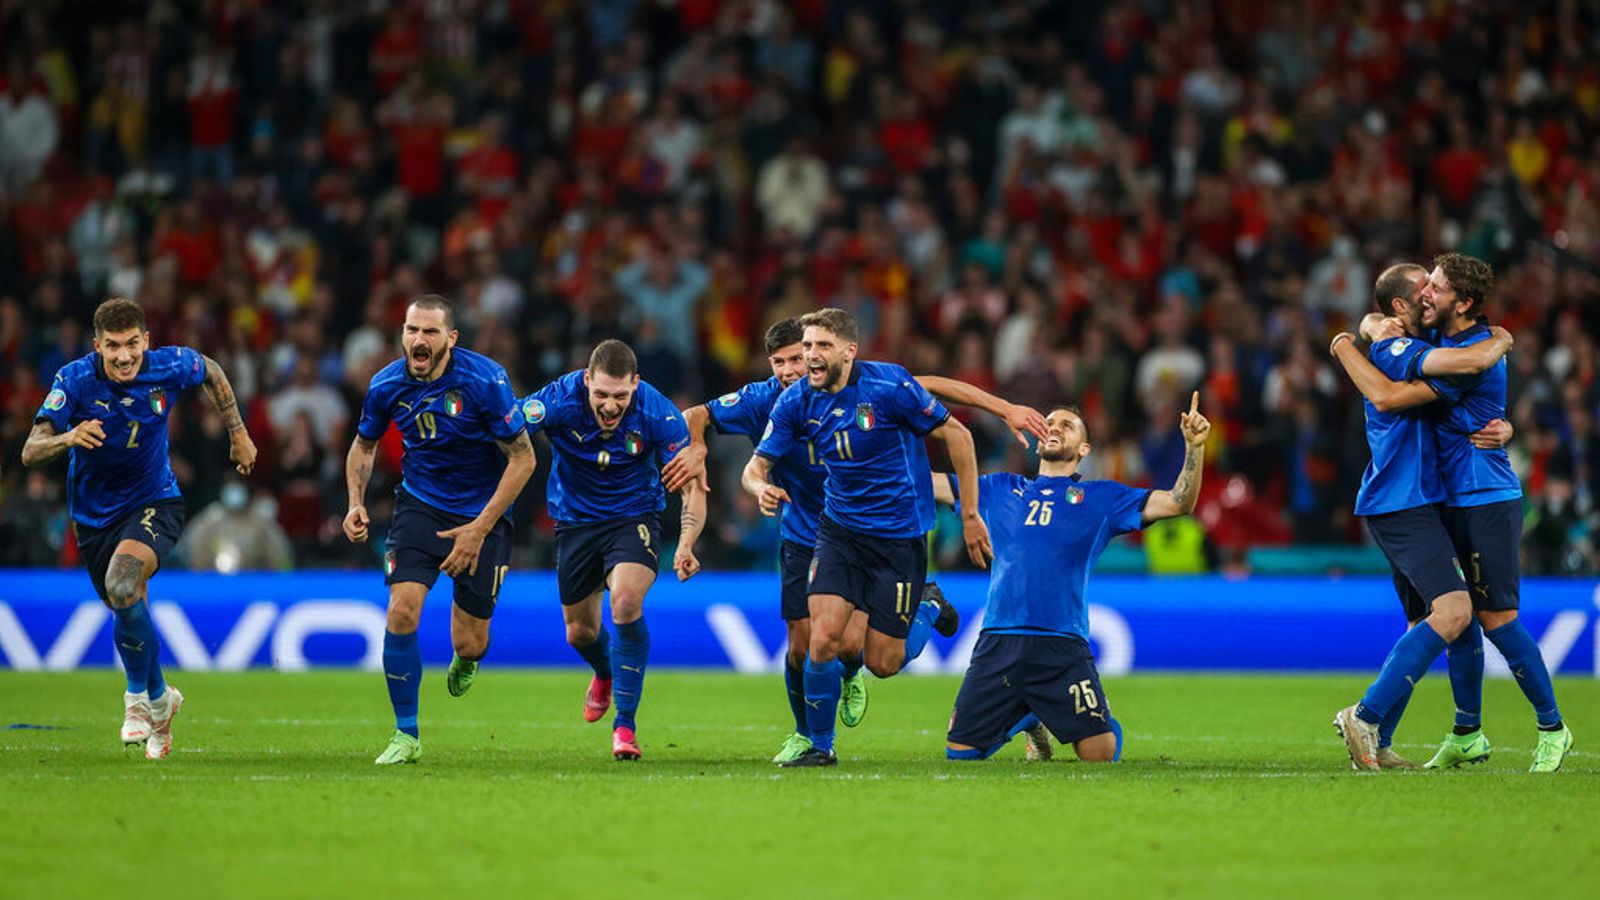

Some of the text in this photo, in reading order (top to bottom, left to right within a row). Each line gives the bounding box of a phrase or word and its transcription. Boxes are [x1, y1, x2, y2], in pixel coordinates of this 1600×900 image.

[126, 420, 140, 449] 2
[416, 412, 437, 439] 19
[834, 431, 853, 460] 11
[140, 507, 156, 527] 2
[1024, 500, 1054, 526] 25
[637, 523, 651, 547] 9
[896, 582, 912, 613] 11
[1069, 680, 1098, 715] 25
